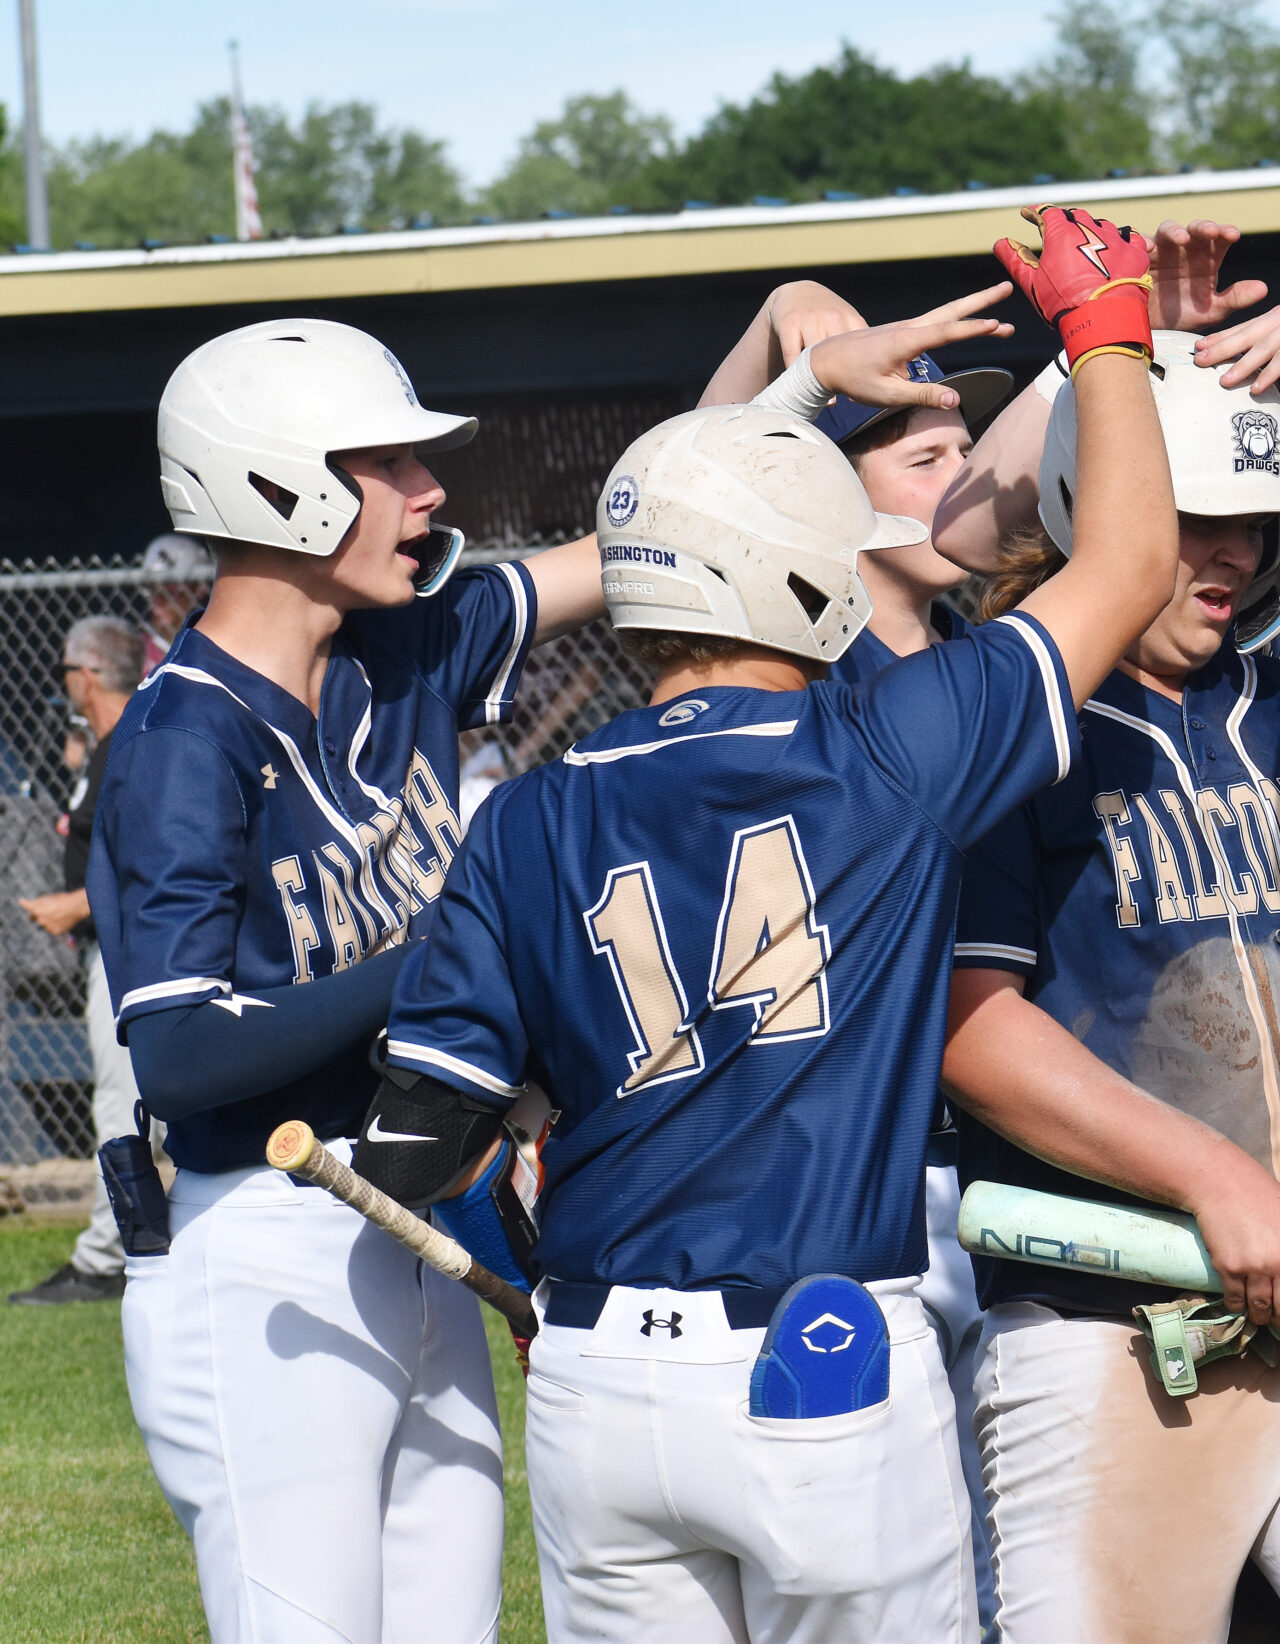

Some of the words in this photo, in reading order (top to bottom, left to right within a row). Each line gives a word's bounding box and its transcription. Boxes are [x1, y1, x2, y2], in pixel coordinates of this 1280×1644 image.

[1234, 458, 1280, 476] DAWGS
[611, 490, 631, 510] 23
[582, 814, 833, 1098] 14
